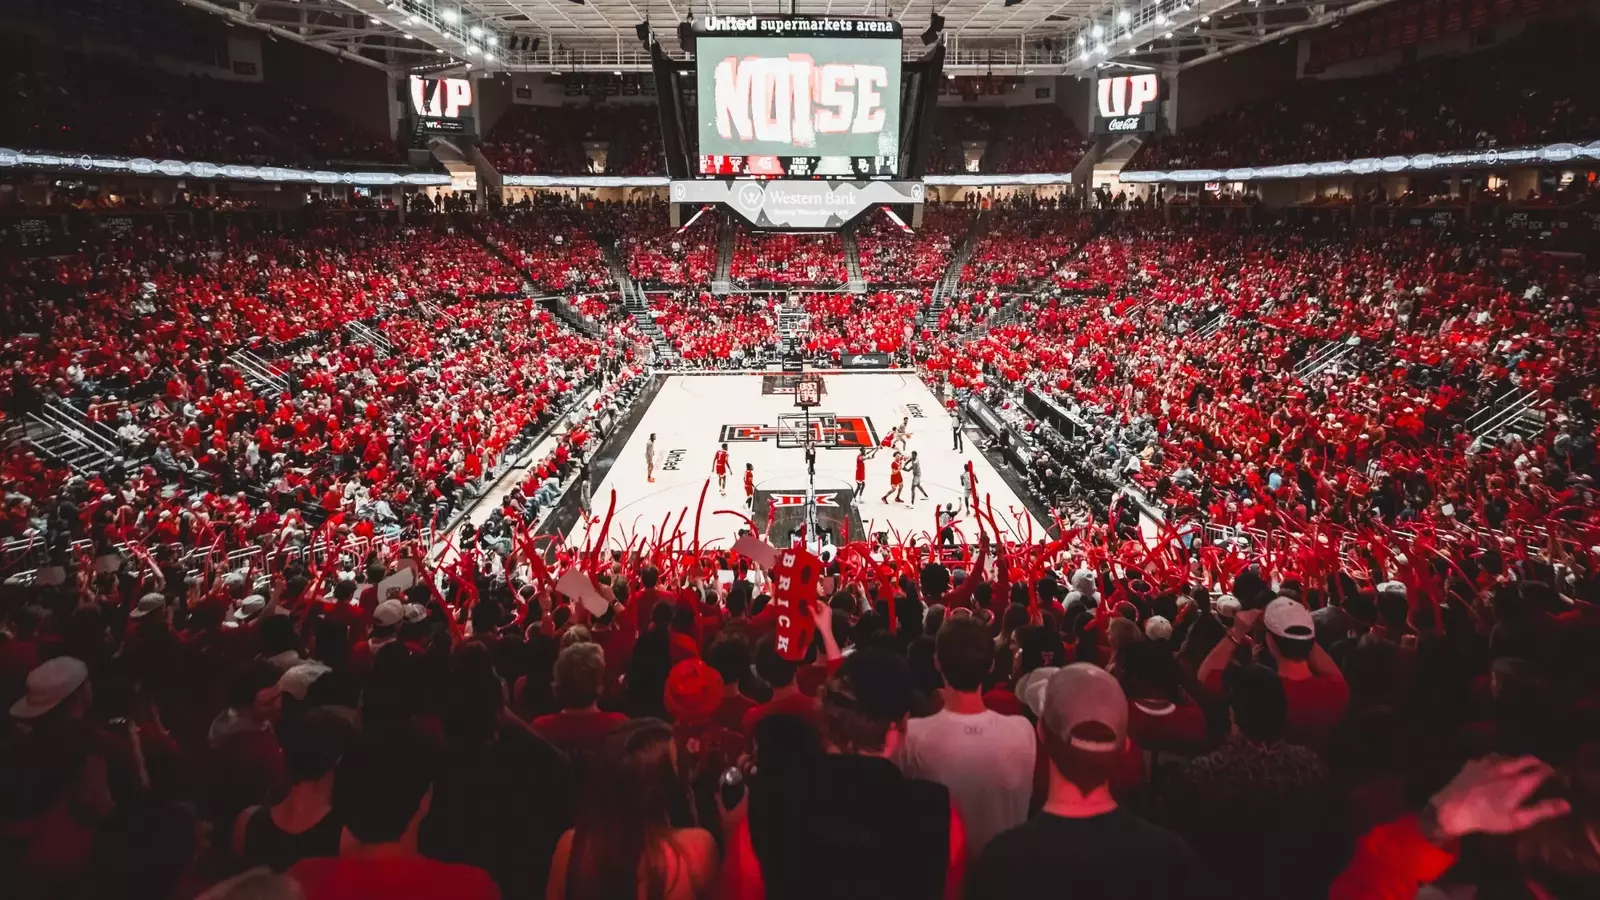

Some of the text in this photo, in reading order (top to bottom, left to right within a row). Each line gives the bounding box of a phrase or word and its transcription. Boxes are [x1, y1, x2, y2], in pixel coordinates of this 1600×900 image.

[705, 16, 894, 33] United supermarkets arena
[714, 53, 888, 147] NOISE
[1098, 74, 1158, 118] UP
[770, 190, 822, 205] Western
[825, 191, 857, 205] Bank
[662, 449, 687, 470] United
[777, 552, 796, 653] BRICK
